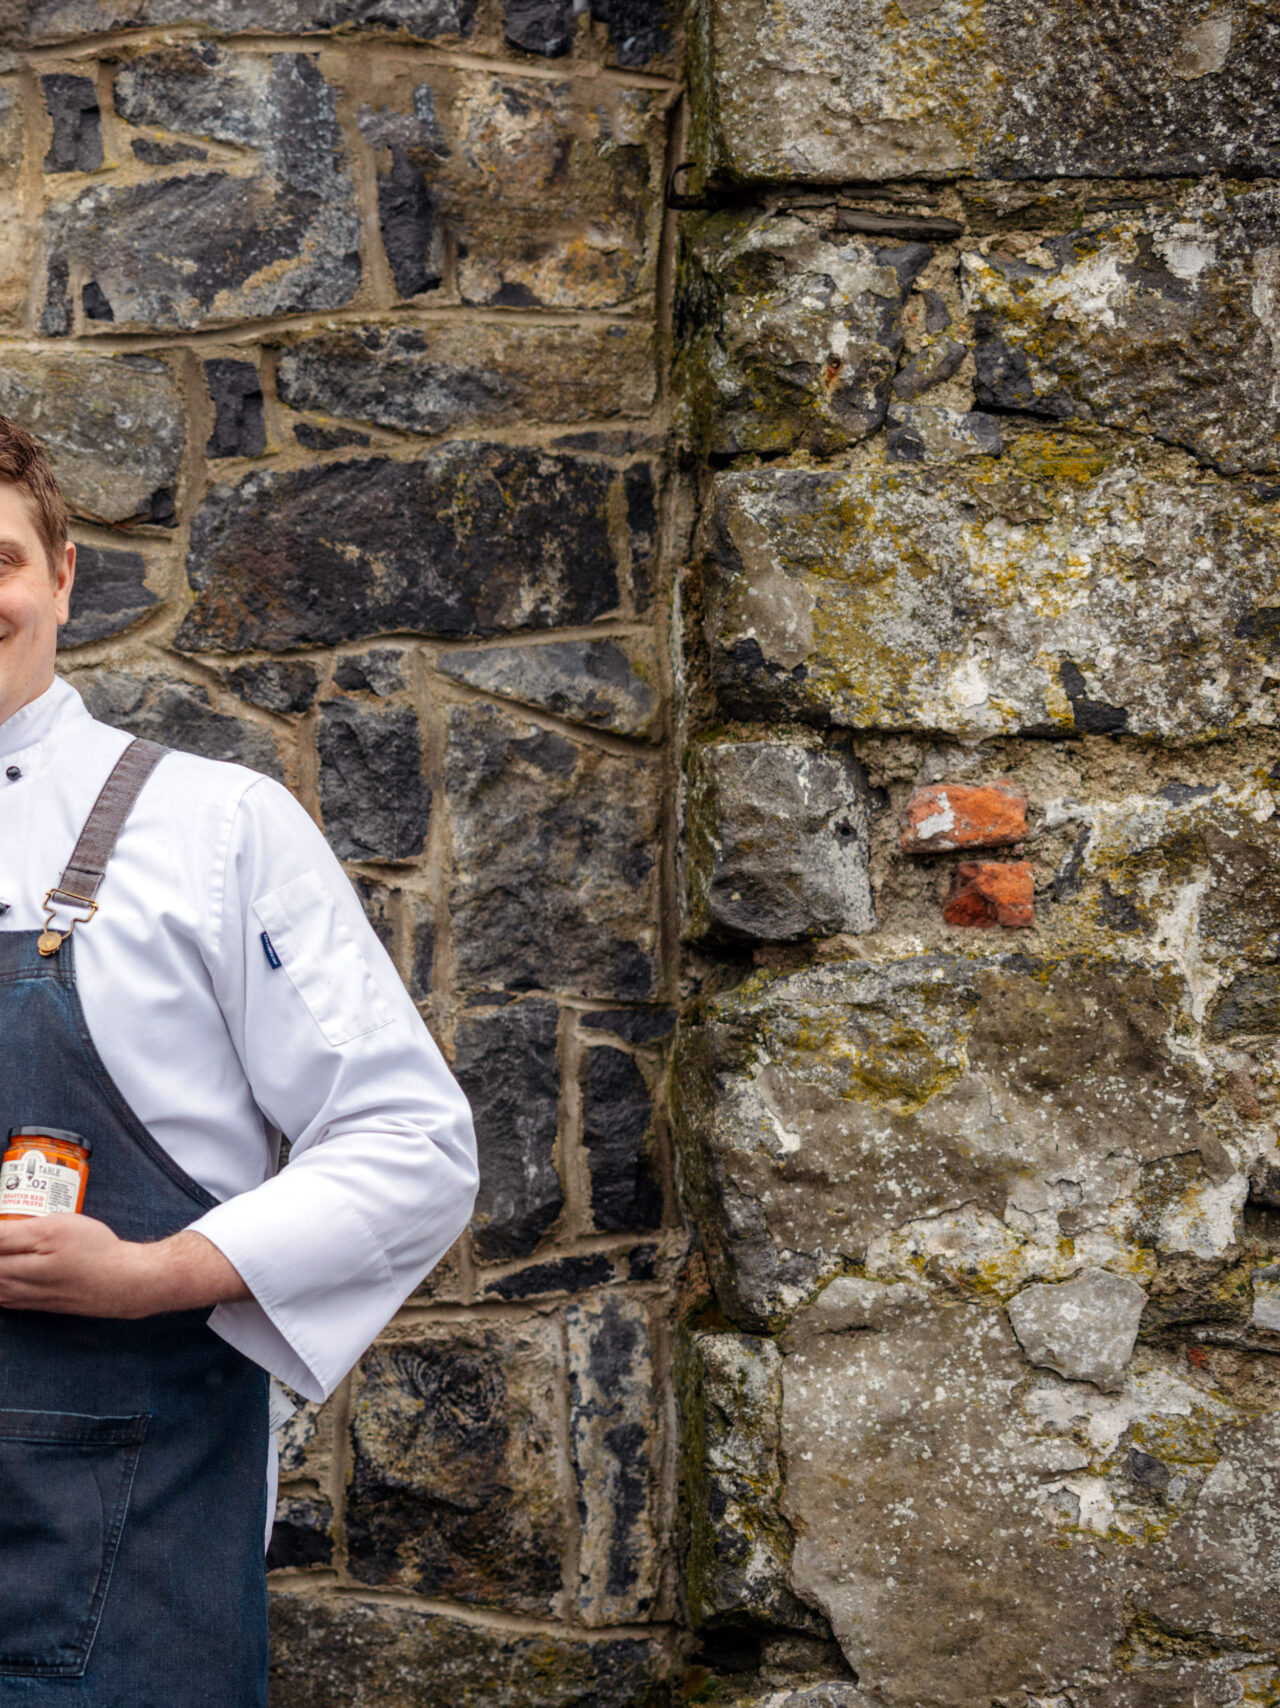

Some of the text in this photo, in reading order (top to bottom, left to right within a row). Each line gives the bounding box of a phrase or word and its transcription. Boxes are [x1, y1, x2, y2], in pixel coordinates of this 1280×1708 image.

[39, 1165, 61, 1177] TABLE
[31, 1179, 47, 1190] 02
[30, 1194, 45, 1202] RED
[22, 1200, 44, 1208] PESTO
